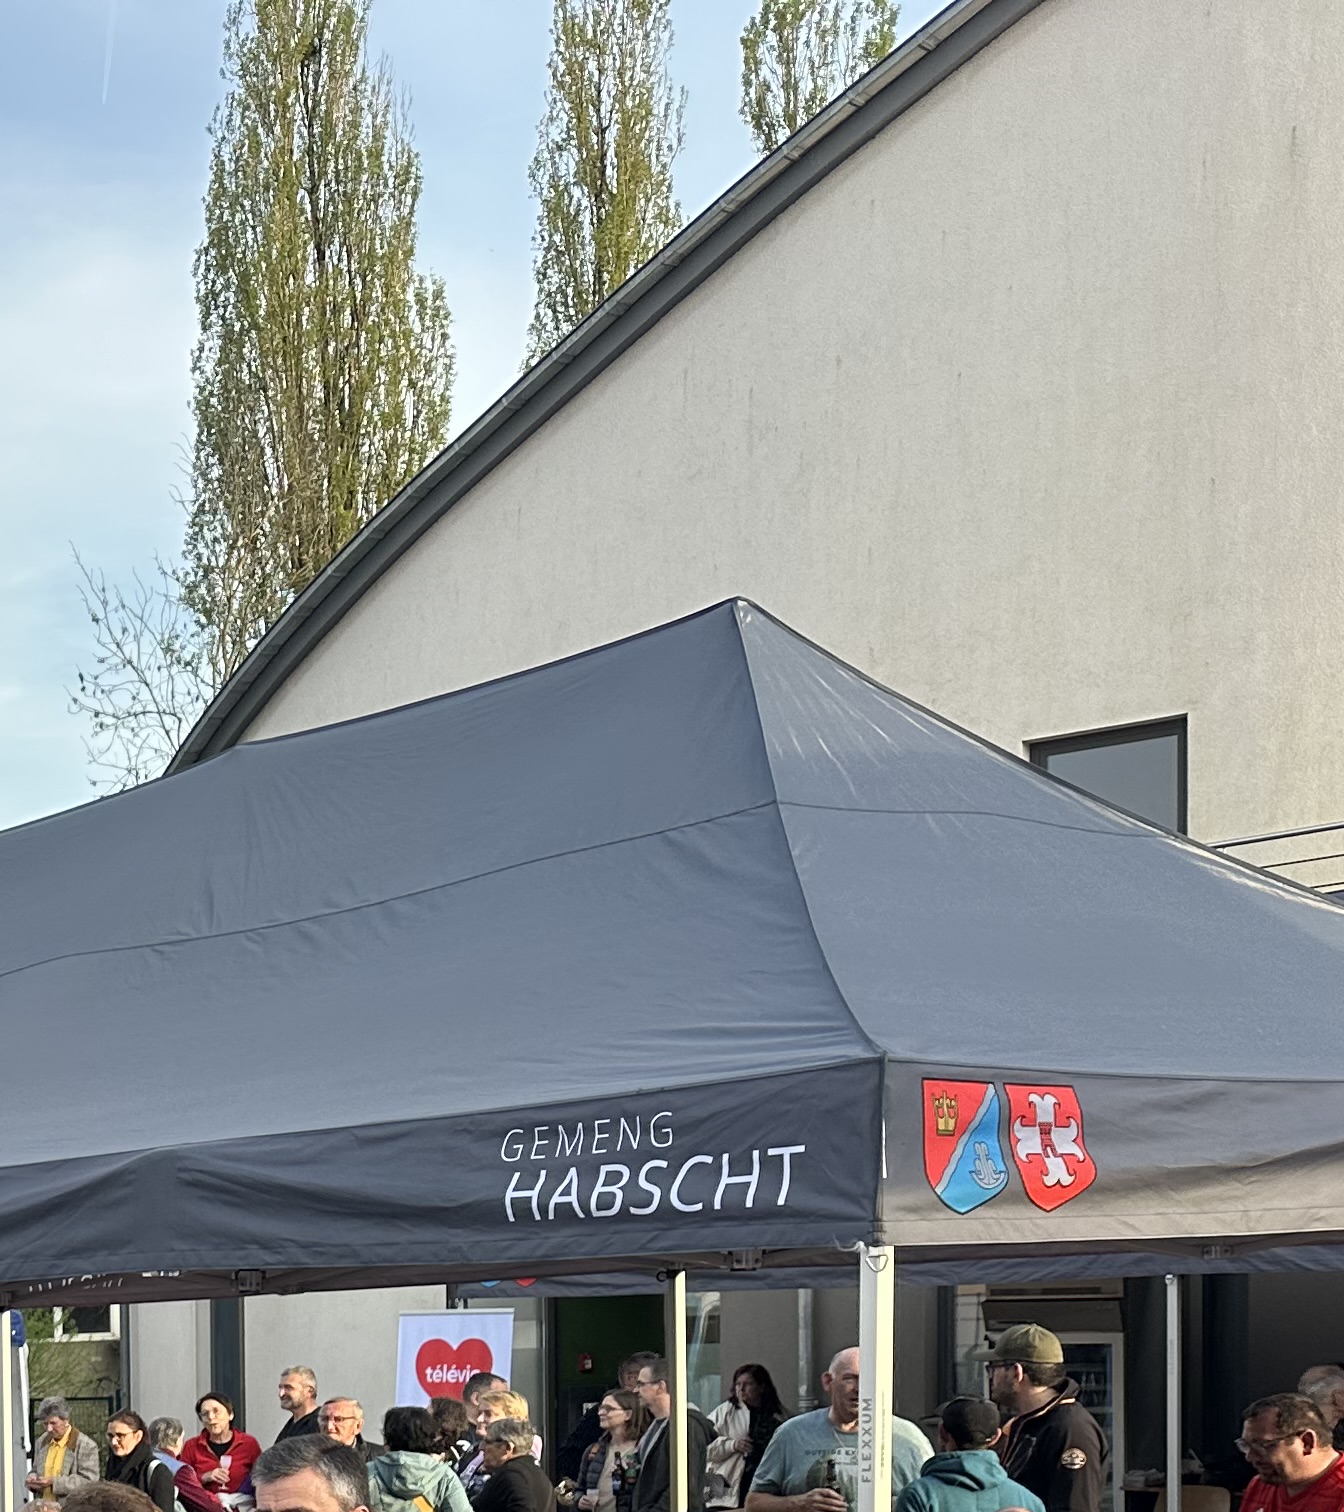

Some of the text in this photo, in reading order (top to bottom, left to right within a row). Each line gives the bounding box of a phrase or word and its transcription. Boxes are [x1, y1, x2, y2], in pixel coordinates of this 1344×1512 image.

[500, 1111, 673, 1162] GEMENG
[504, 1144, 806, 1222] HABSCHT
[861, 1398, 873, 1483] FLEXXUM
